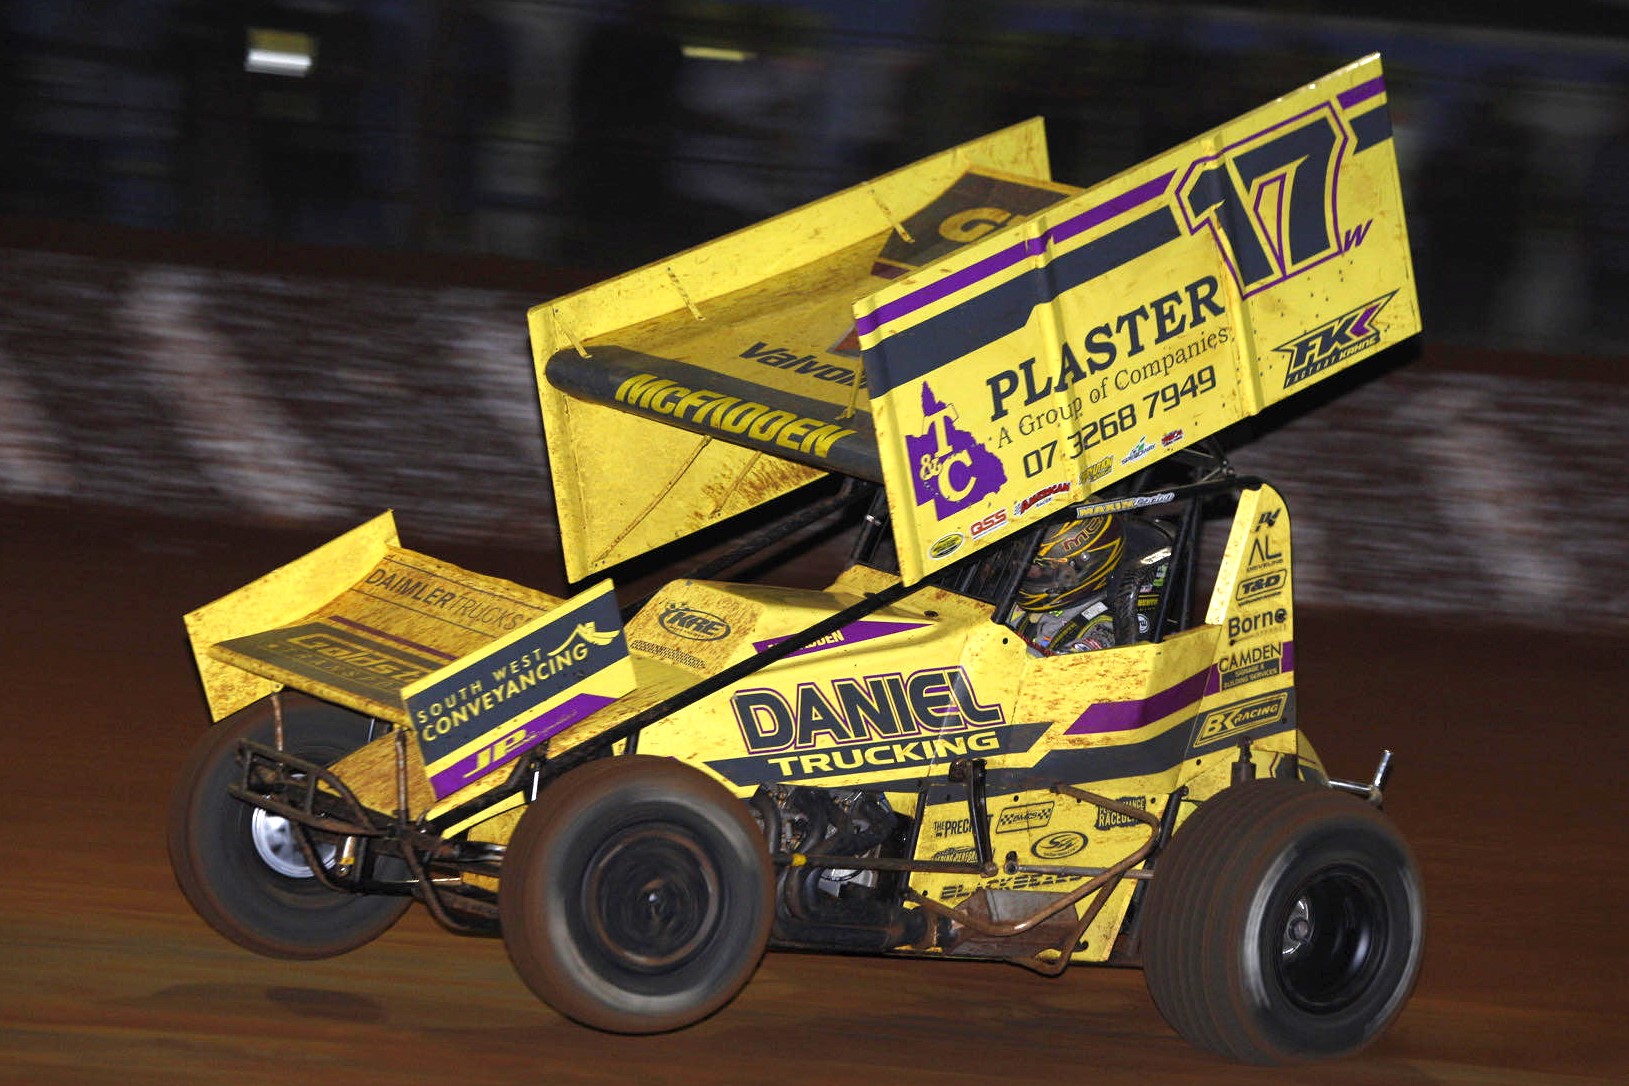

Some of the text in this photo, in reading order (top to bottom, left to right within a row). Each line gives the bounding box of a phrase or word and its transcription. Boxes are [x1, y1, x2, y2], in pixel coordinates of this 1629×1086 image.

[1175, 101, 1348, 298] 17
[986, 275, 1226, 422] PLASTER
[997, 327, 1229, 449] A Group of Companies
[1023, 440, 1057, 478] 07
[1067, 403, 1137, 459] 3268
[1143, 365, 1216, 419] 7949
[416, 648, 543, 724] SOUTH WEST
[421, 642, 589, 742] CONVEYANCING
[1219, 641, 1282, 672] CAMDEN
[730, 665, 1006, 754] DANIEL
[768, 731, 1000, 776] TRUCKING
[1234, 703, 1279, 725] RACING
